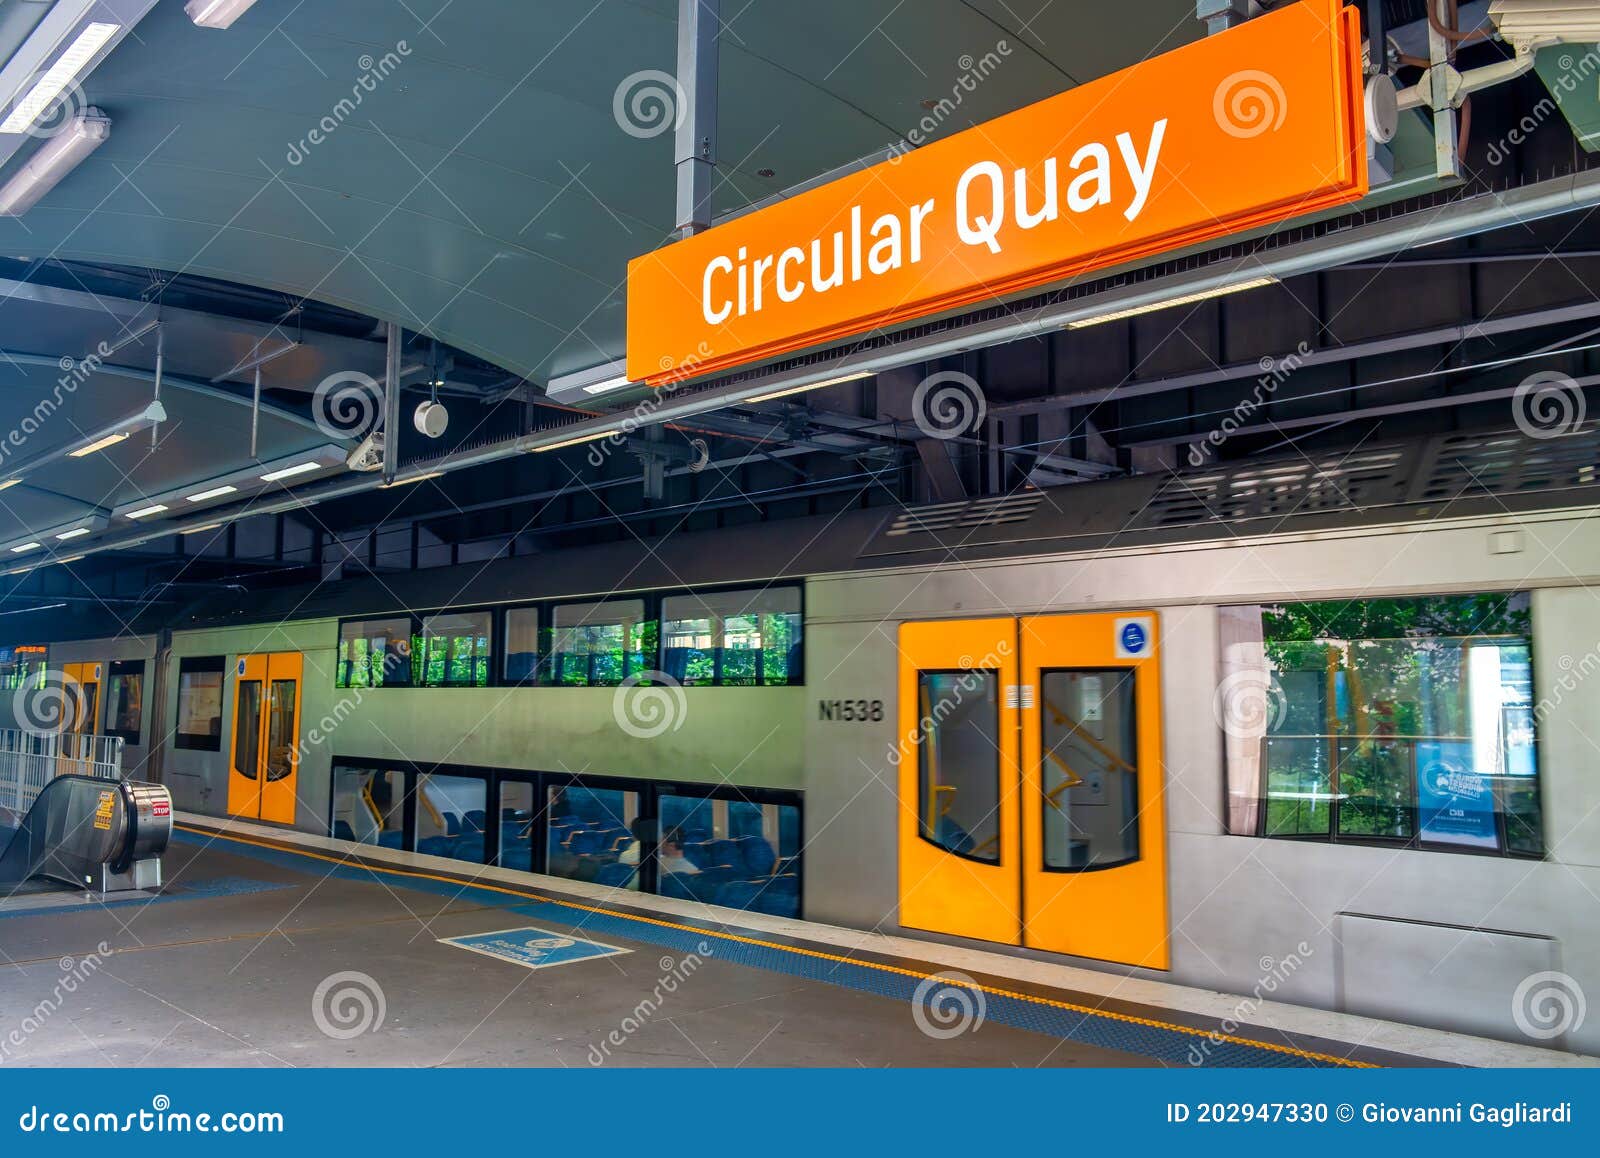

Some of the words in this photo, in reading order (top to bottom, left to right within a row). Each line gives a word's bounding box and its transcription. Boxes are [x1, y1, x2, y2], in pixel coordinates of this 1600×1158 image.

[701, 197, 936, 326] Circular
[954, 117, 1168, 255] Quay
[819, 699, 884, 721] N1538
